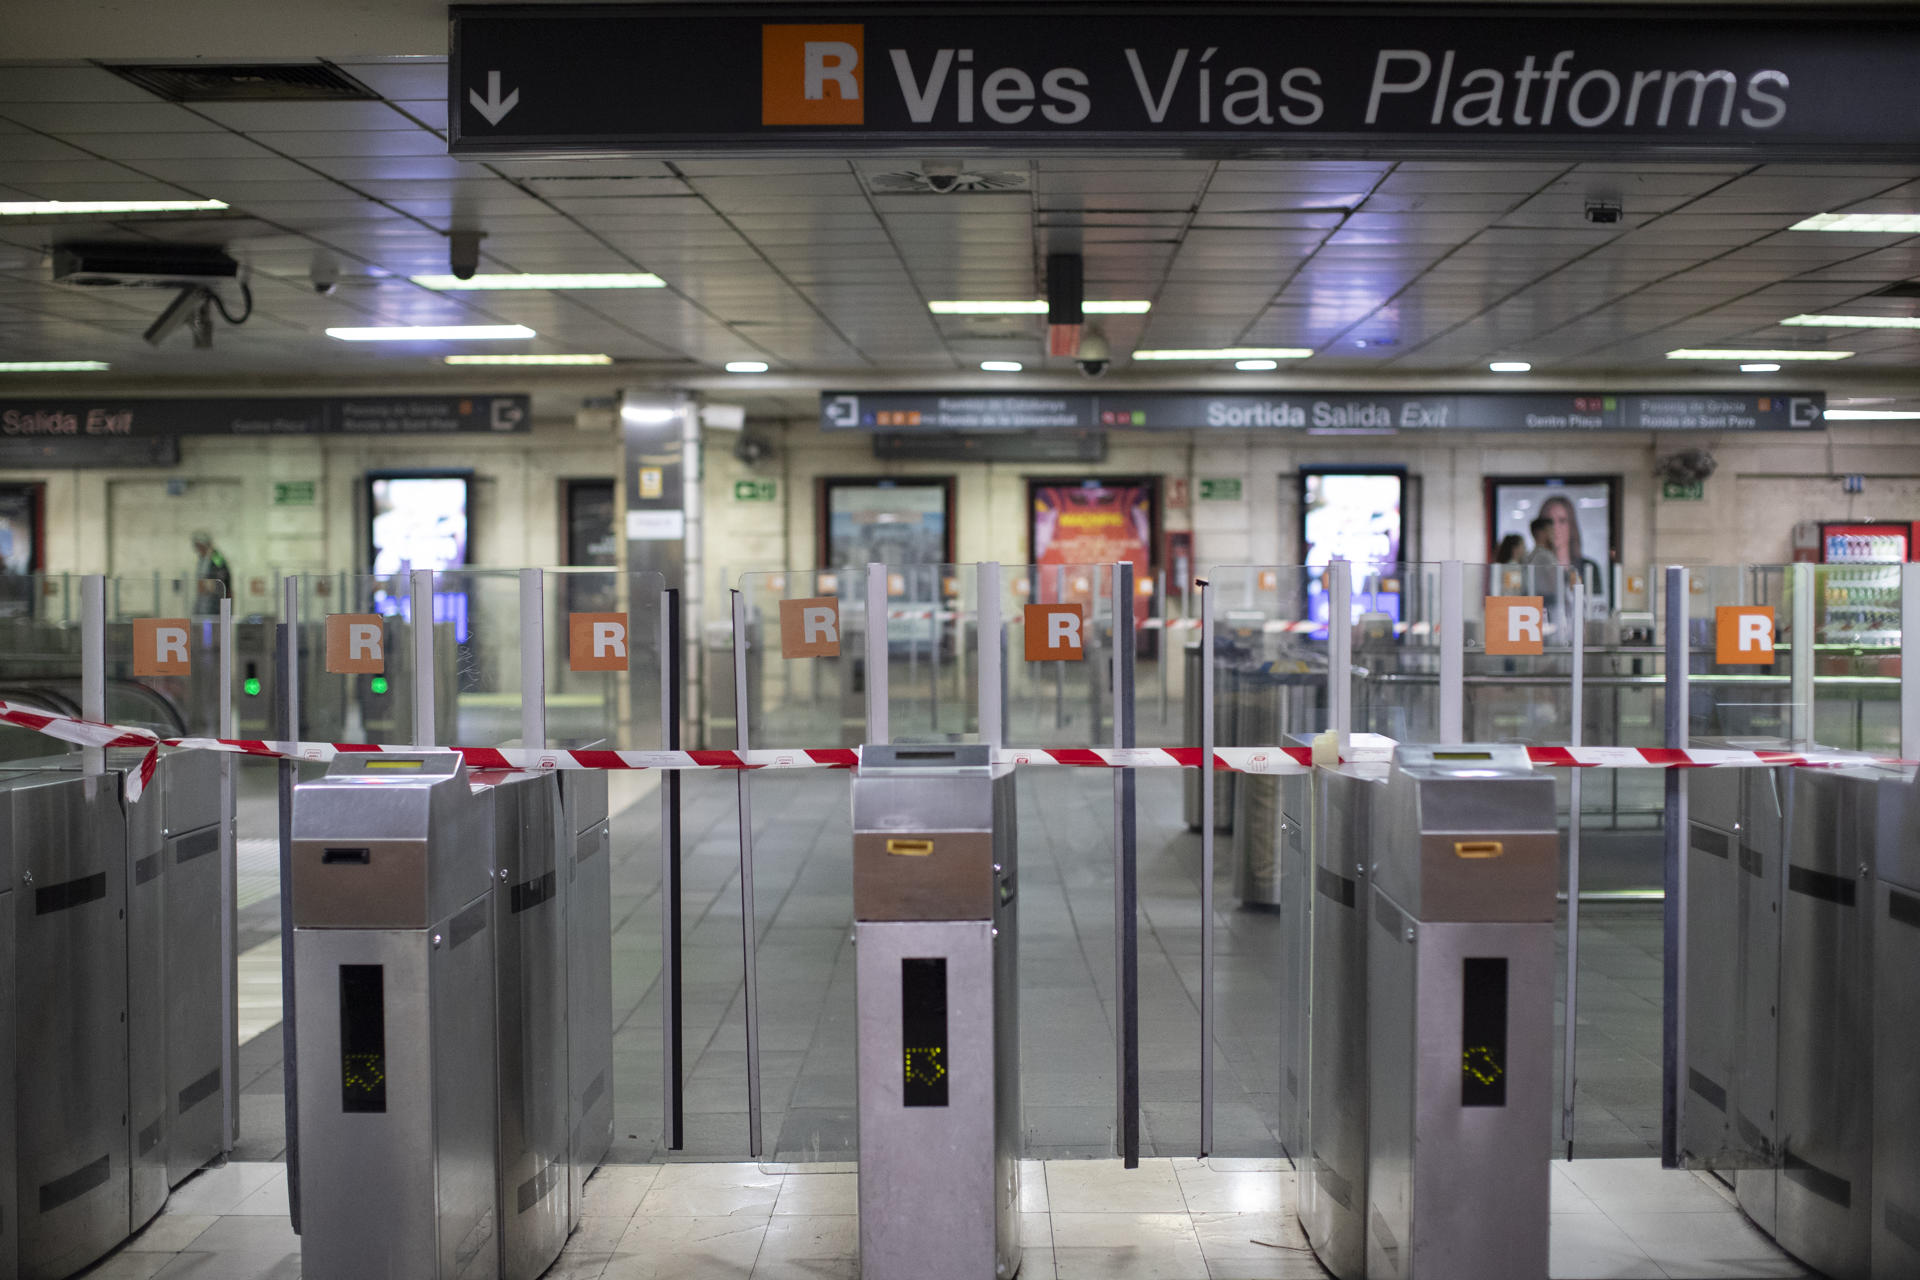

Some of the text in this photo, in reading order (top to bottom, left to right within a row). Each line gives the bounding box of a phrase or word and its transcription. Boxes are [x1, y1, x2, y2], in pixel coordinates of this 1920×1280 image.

[804, 41, 1791, 129] R Vies Vías Platforms
[2, 409, 134, 434] Salida Exit
[1206, 402, 1449, 427] Sortida Salida Exit
[350, 623, 382, 660] R
[593, 621, 626, 658] R
[804, 606, 837, 643] R
[1048, 612, 1081, 649] R
[1508, 605, 1541, 642] R
[1739, 614, 1773, 652] R
[156, 627, 189, 663] R
